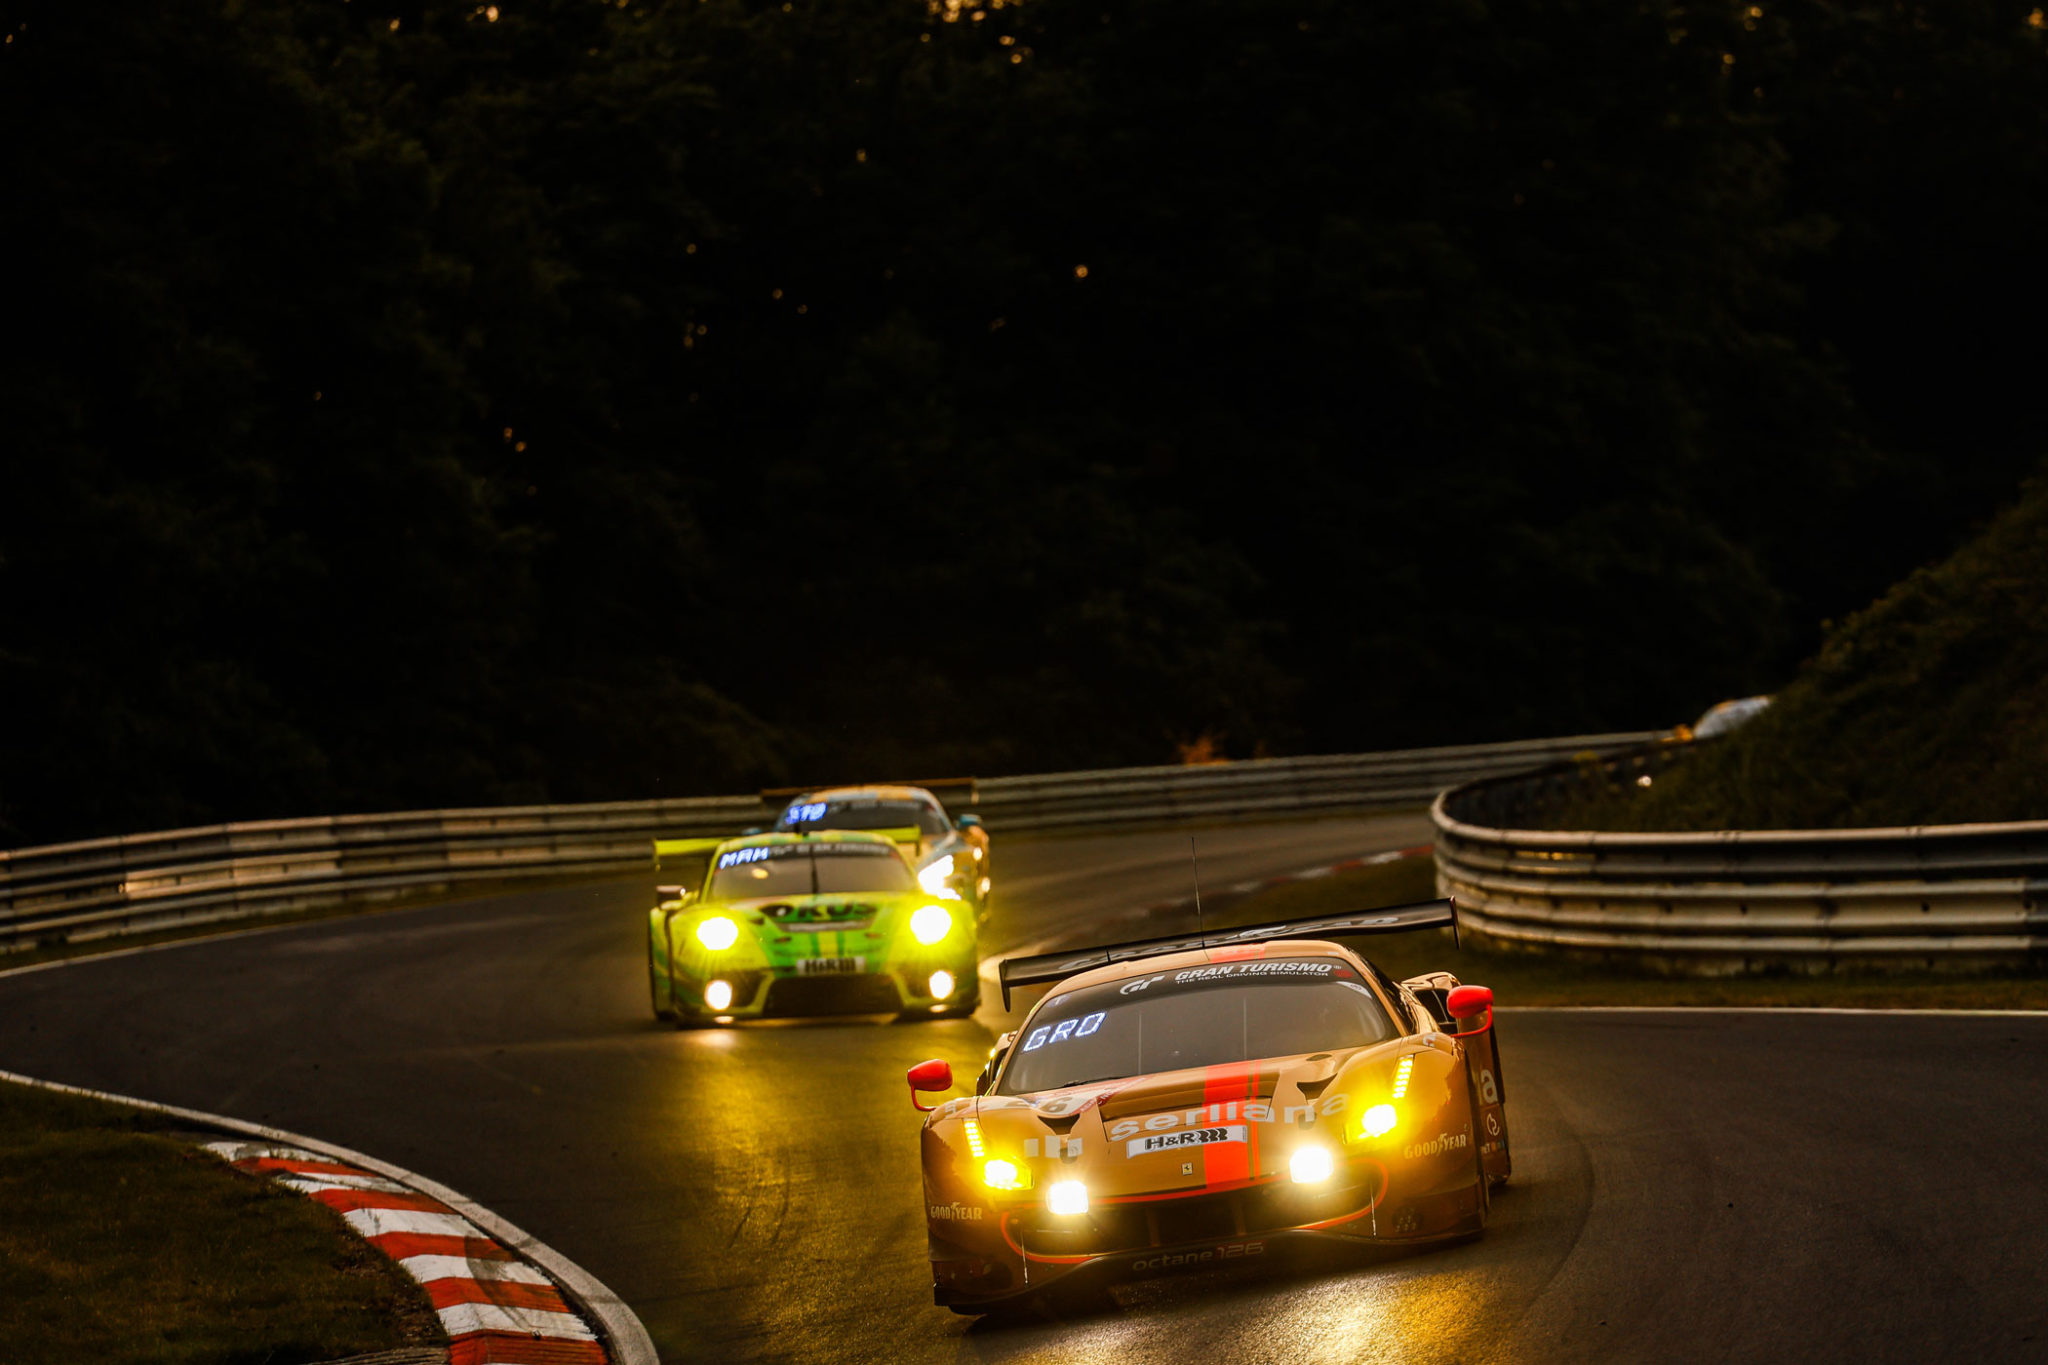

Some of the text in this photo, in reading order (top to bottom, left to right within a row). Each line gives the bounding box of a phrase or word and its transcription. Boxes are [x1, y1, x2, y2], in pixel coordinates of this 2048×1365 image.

[1174, 965, 1234, 981] GRAN
[1240, 962, 1333, 973] TURISMO
[1110, 1093, 1349, 1142] serliana
